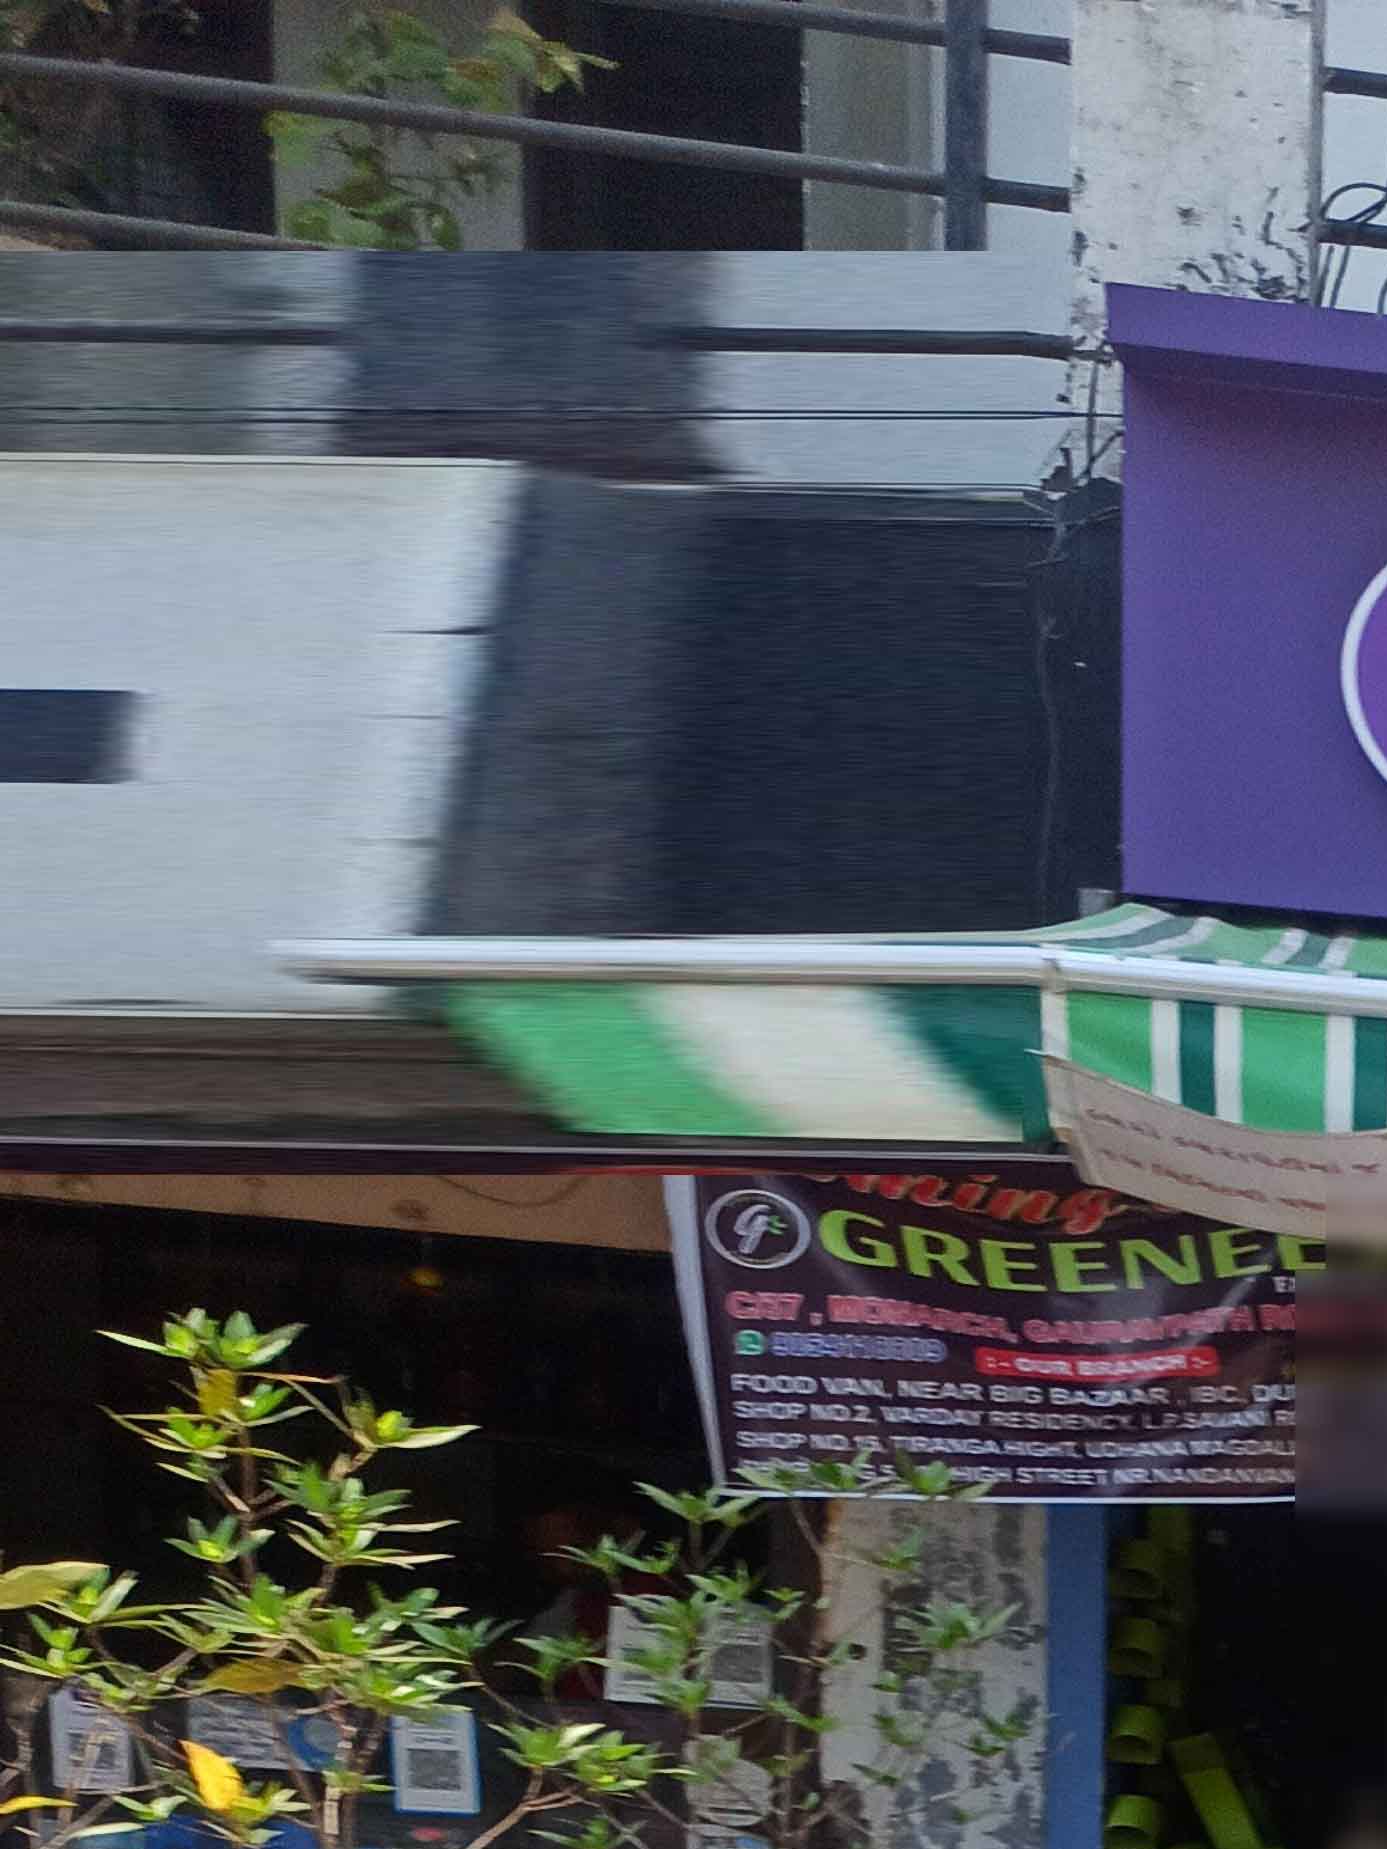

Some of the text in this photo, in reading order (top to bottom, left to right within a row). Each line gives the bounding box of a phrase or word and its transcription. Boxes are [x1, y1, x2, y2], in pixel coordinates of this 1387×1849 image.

[1013, 1356, 1073, 1377] OUR
[1075, 1354, 1188, 1377] BRANCH
[730, 1373, 818, 1395] FOOD
[896, 1379, 984, 1402] NEAR
[989, 1383, 1042, 1404] BIG
[1049, 1386, 1171, 1407] BAZAAR
[732, 1400, 807, 1421] SHOP
[736, 1430, 808, 1450] SHOP
[1015, 1467, 1108, 1486] STREET
